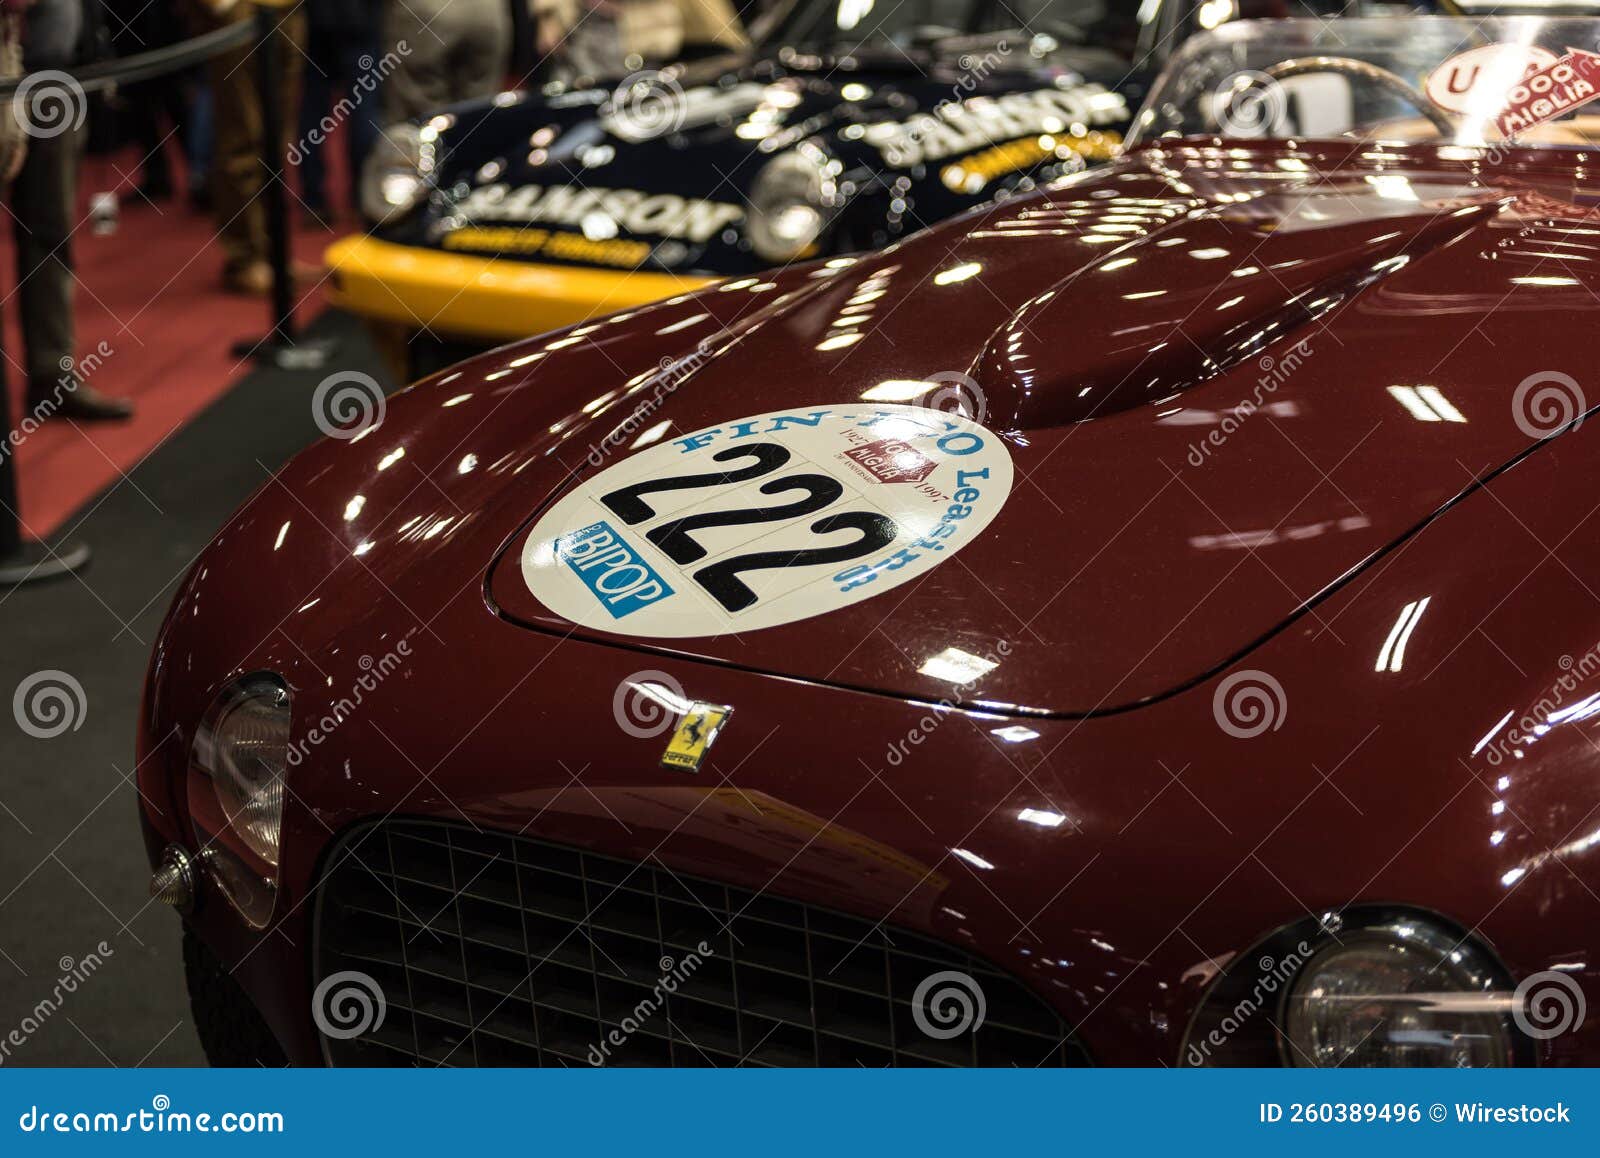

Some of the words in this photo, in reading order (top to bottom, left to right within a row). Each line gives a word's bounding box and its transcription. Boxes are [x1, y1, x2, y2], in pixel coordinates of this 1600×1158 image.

[1498, 64, 1573, 110] 000
[1503, 80, 1595, 134] MIGLIA
[914, 482, 949, 503] 1997
[600, 442, 898, 613] 222
[566, 530, 663, 605] BIPOP
